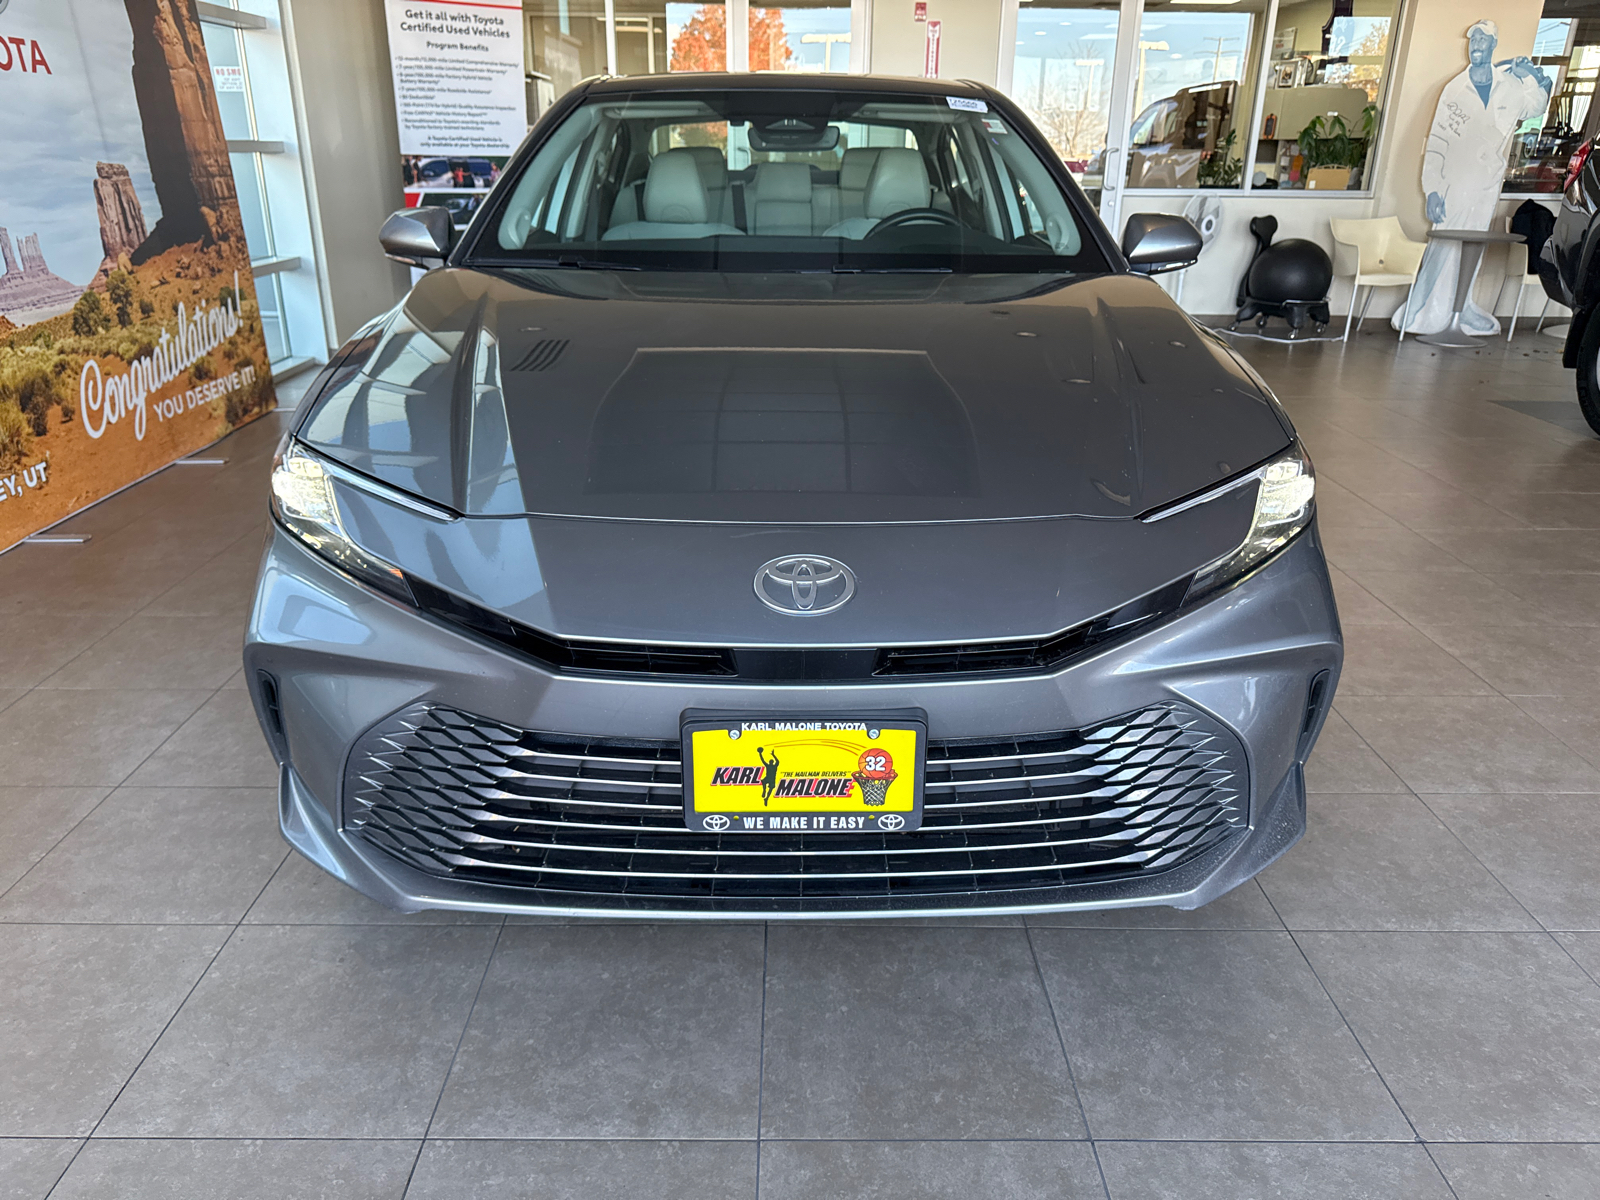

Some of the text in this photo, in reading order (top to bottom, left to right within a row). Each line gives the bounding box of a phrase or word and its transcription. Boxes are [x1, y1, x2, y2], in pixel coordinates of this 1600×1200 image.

[405, 9, 504, 26] Get it all with Toyota
[400, 22, 510, 38] Certified Used Vehicles
[426, 41, 489, 52] Program Benefits
[80, 270, 244, 441] Congratulations!
[152, 365, 256, 422] YOU DESERVE IT!
[24, 461, 48, 489] UT
[741, 722, 867, 731] KARL MALONE TOYOTA
[866, 756, 886, 772] 32
[711, 766, 764, 786] KARL
[774, 778, 854, 798] MALONE
[743, 816, 865, 829] WE MAKE IT EASY
